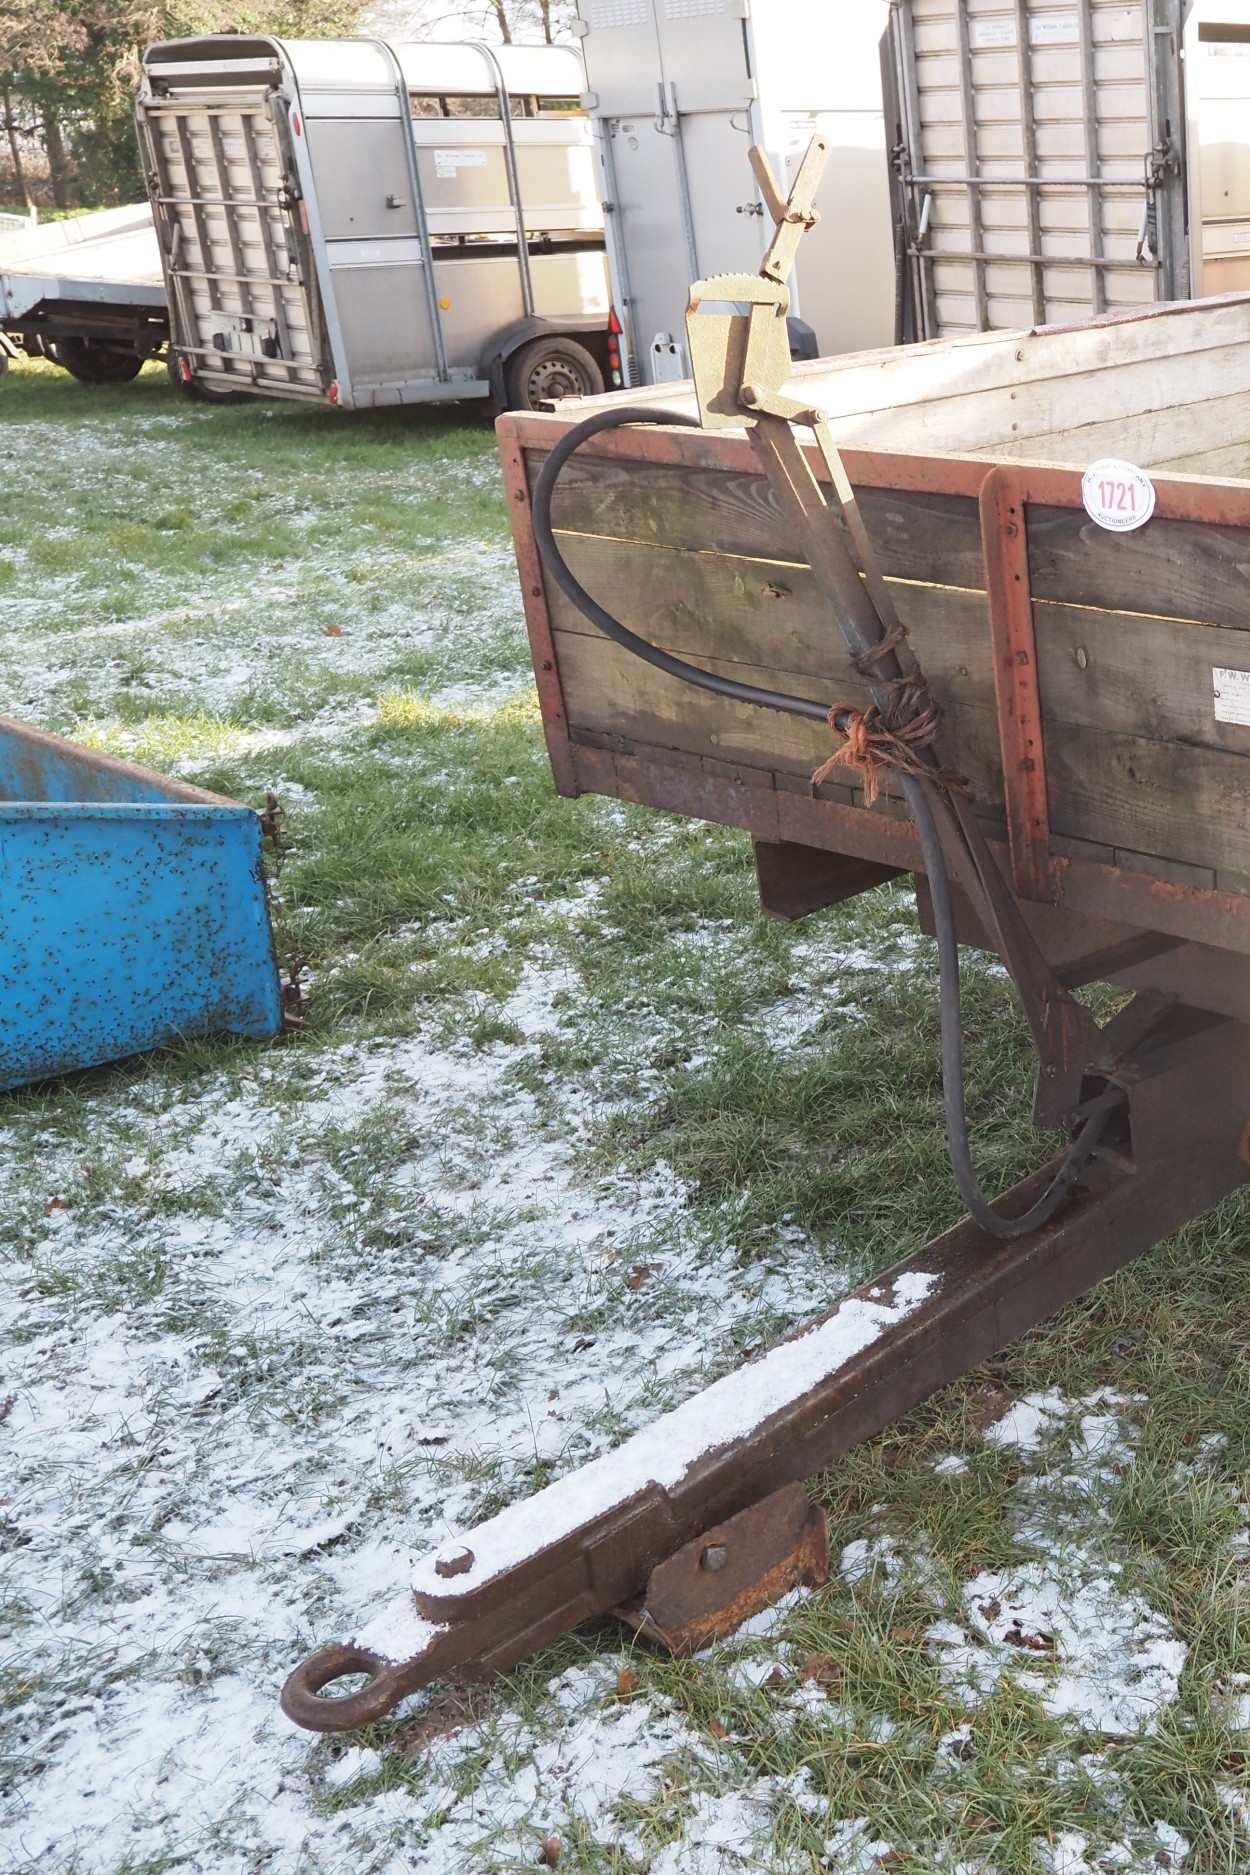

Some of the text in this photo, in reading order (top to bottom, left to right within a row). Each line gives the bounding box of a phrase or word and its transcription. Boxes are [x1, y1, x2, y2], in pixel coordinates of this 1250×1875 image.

[1098, 480, 1136, 512] 1721
[1097, 511, 1137, 525] AUCTIONEERS
[1228, 671, 1239, 681] W.
